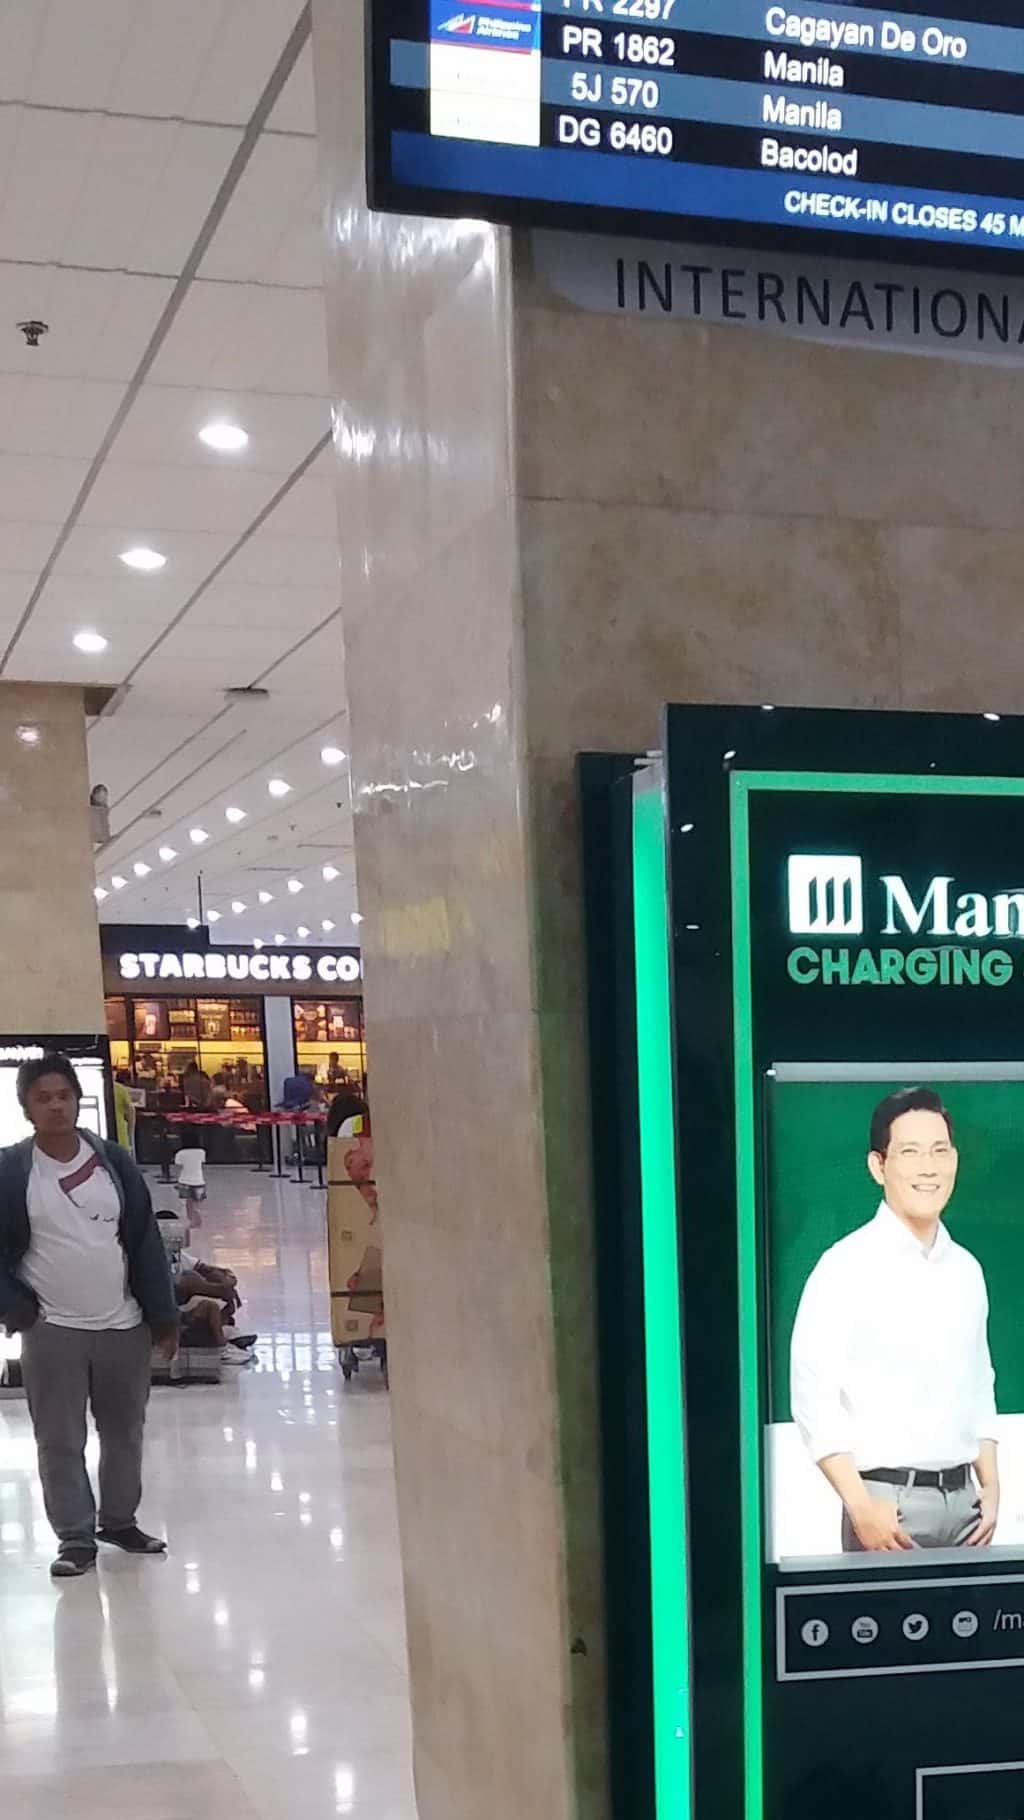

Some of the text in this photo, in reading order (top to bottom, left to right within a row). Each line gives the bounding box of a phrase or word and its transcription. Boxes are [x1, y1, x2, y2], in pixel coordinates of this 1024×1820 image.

[562, 24, 603, 58] PR
[613, 31, 676, 67] 1862
[763, 49, 845, 88] Manila
[765, 6, 874, 49] Cagayan
[880, 20, 916, 52] De
[921, 27, 968, 59] Oro
[571, 71, 602, 102] 5J
[610, 76, 659, 109] 570
[762, 93, 843, 131] Manila
[558, 114, 601, 147] DG
[610, 121, 673, 154] 6460
[760, 137, 858, 177] Bacolod
[783, 190, 889, 225] CHECK-IN
[891, 202, 978, 233] CLOSES
[980, 211, 1005, 236] 45
[119, 952, 312, 981] STARBUCKS
[787, 946, 1014, 986] CHARGING
